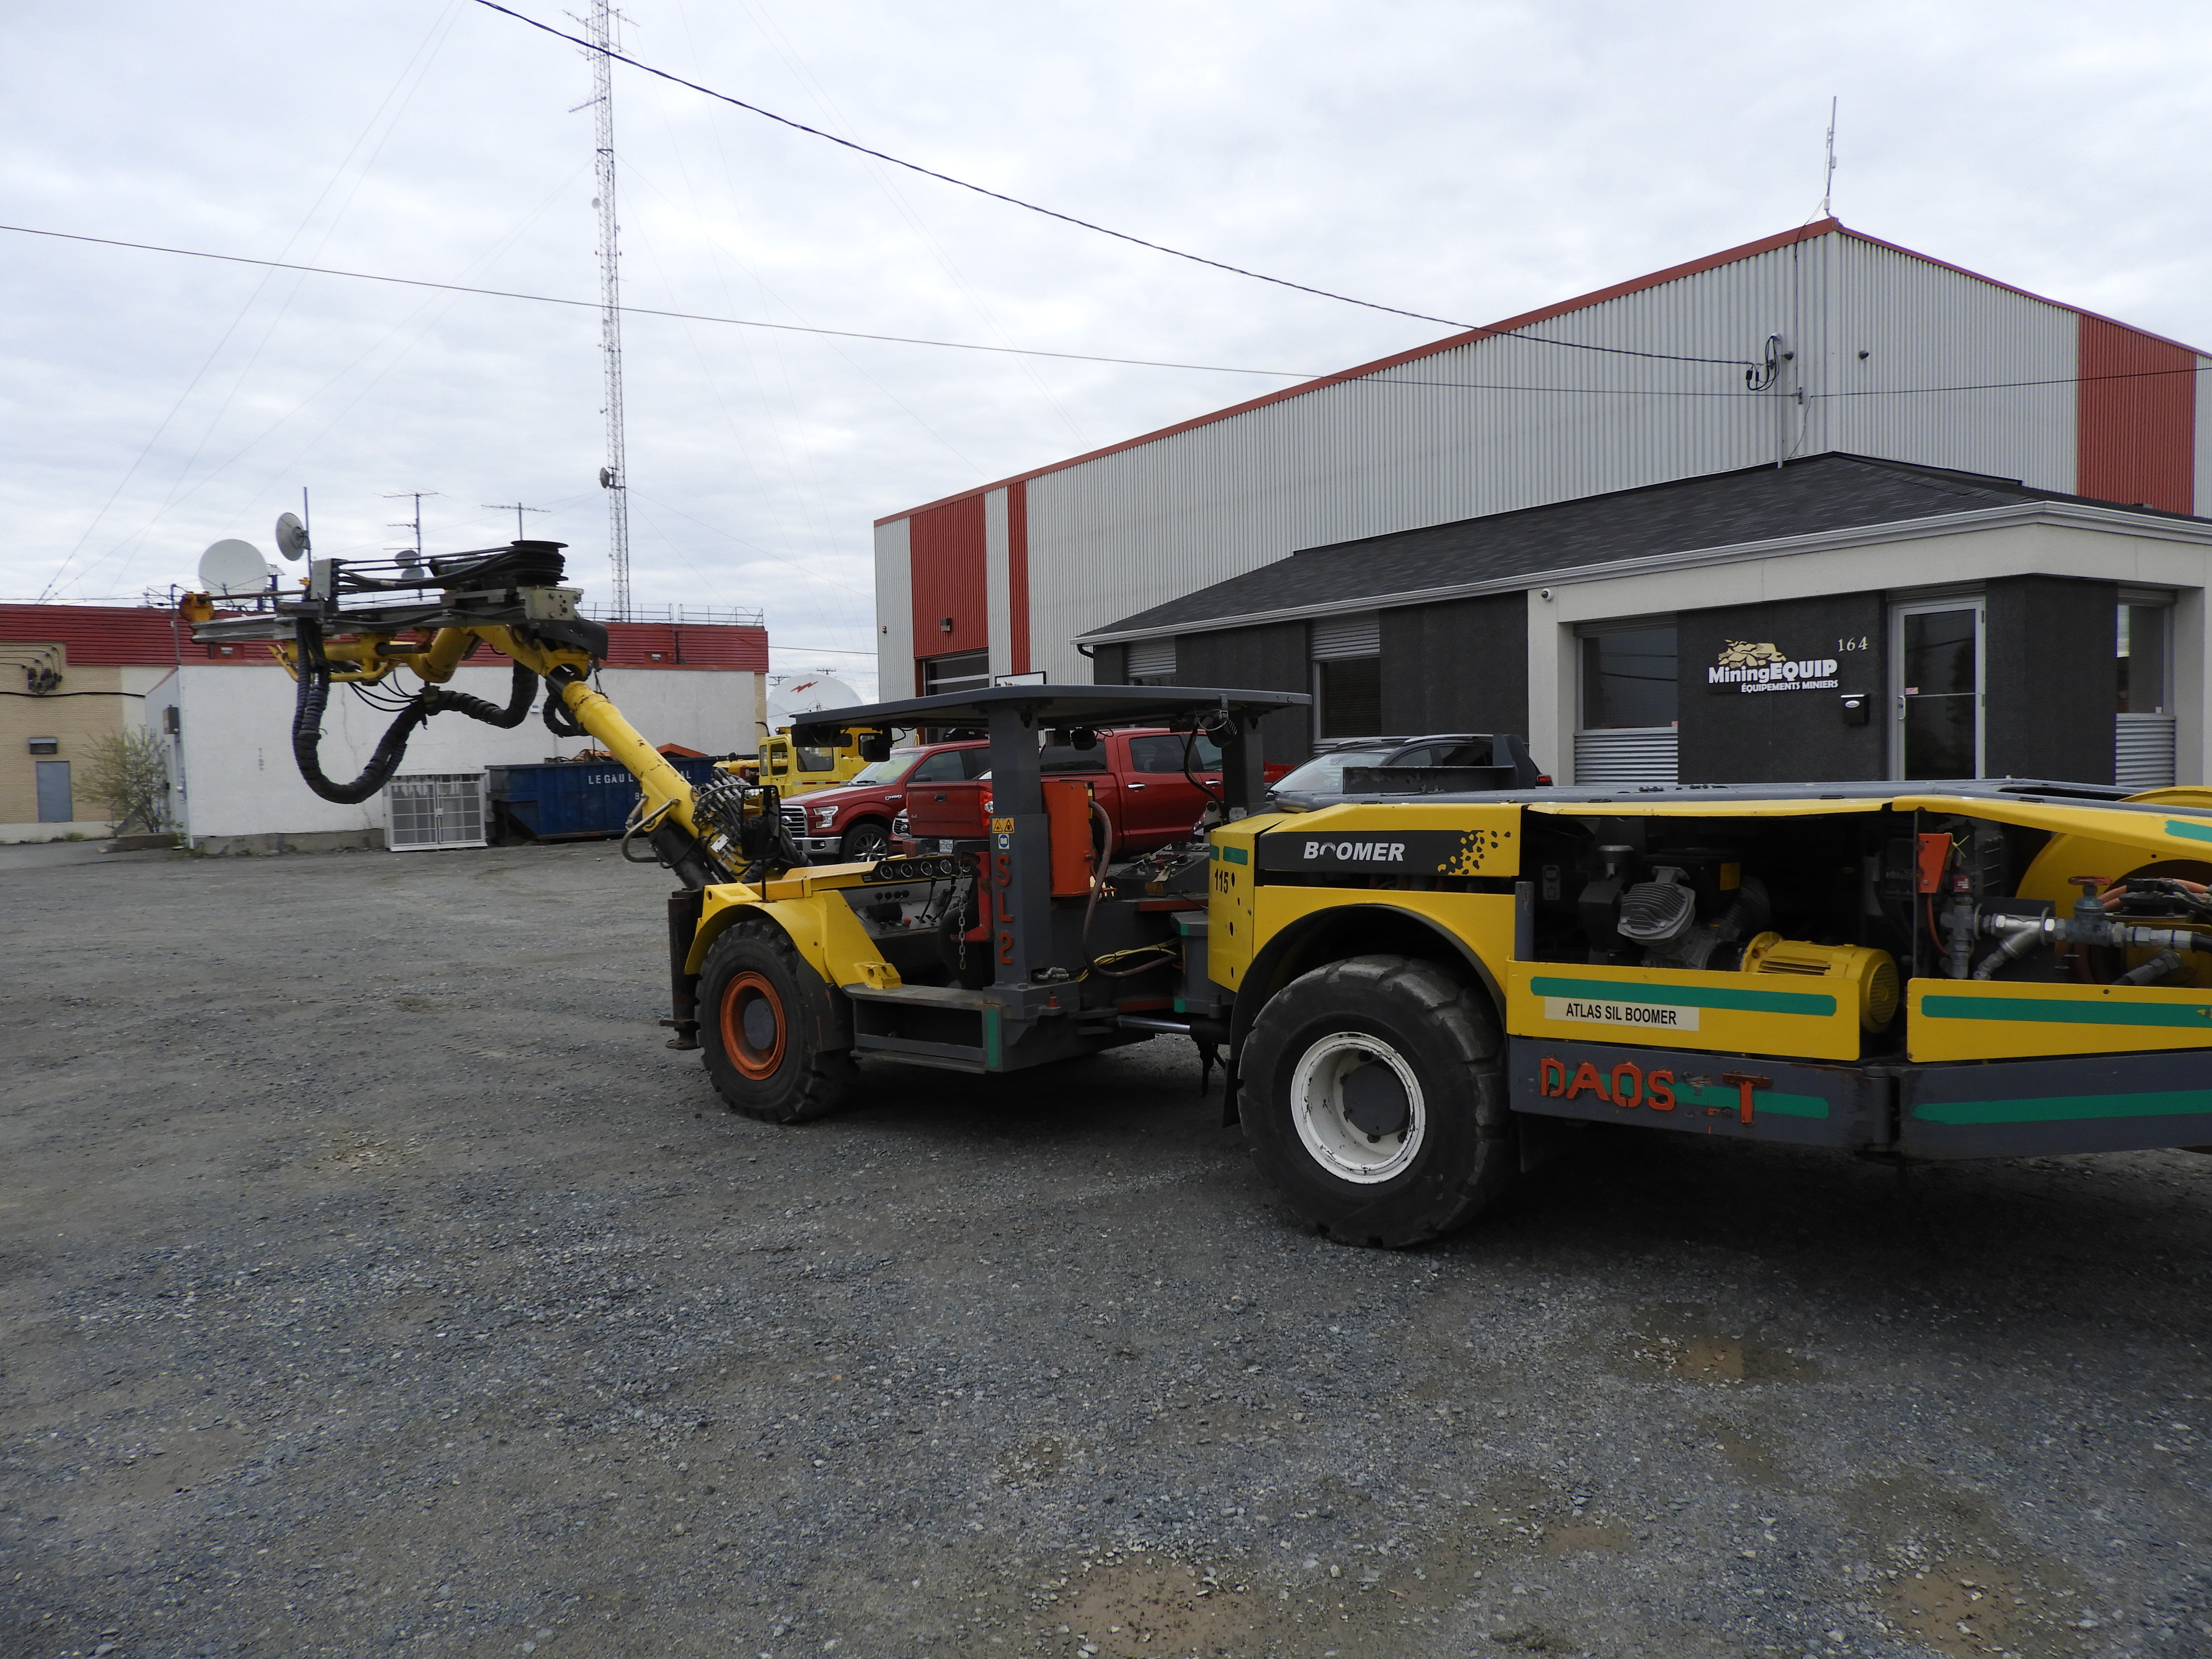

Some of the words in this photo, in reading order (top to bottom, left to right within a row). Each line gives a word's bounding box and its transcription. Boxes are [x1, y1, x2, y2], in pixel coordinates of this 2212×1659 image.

[1838, 636, 1869, 652] 164
[1708, 659, 1838, 683] MiningEQUIP
[1740, 682, 1801, 693] ÉQUIPEMENTS
[1802, 680, 1839, 690] MINIERS
[588, 773, 634, 785] LEGAUL
[1214, 868, 1228, 894] 115
[1566, 1003, 1601, 1019] ATLAS
[1605, 1005, 1622, 1021] SIL
[1625, 1007, 1676, 1025] BOOMER
